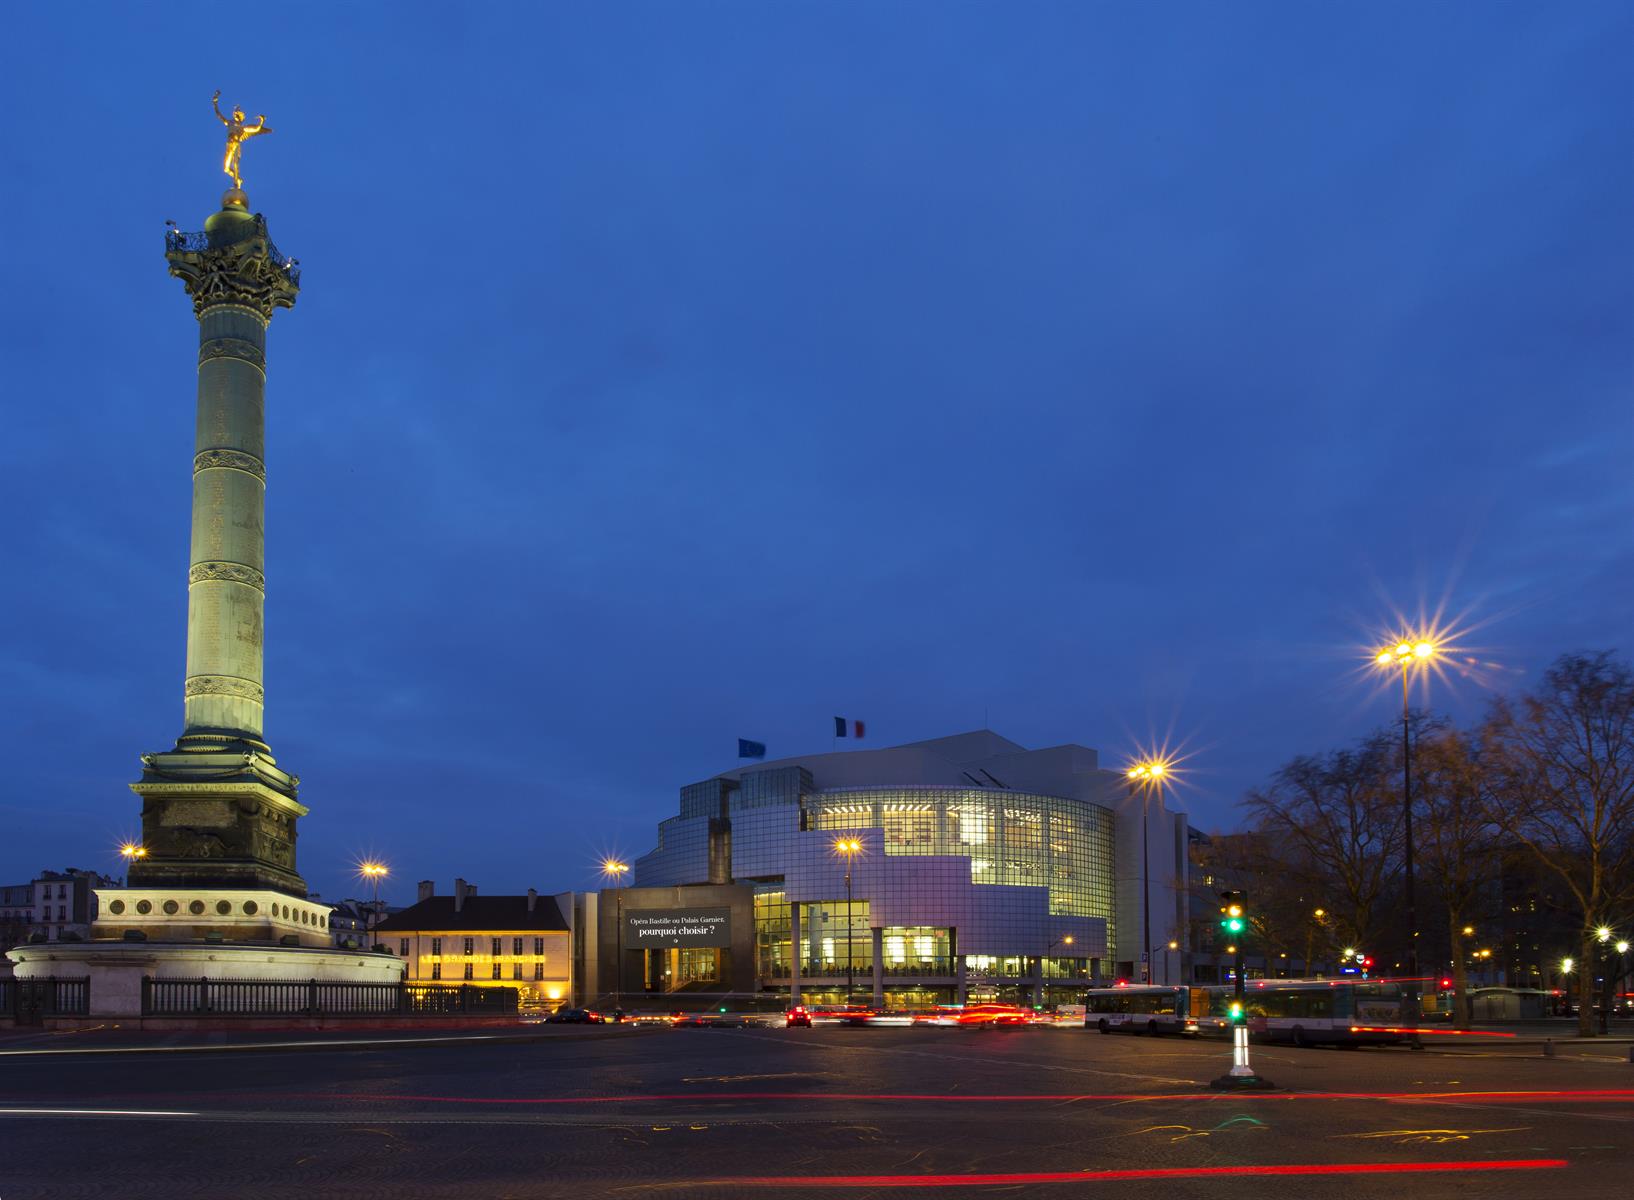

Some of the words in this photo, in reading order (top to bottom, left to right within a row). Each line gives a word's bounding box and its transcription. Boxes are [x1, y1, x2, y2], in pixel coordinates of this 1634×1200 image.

[630, 918, 648, 926] Opéra
[639, 926, 677, 937] pourquoi
[678, 926, 708, 935] choisir
